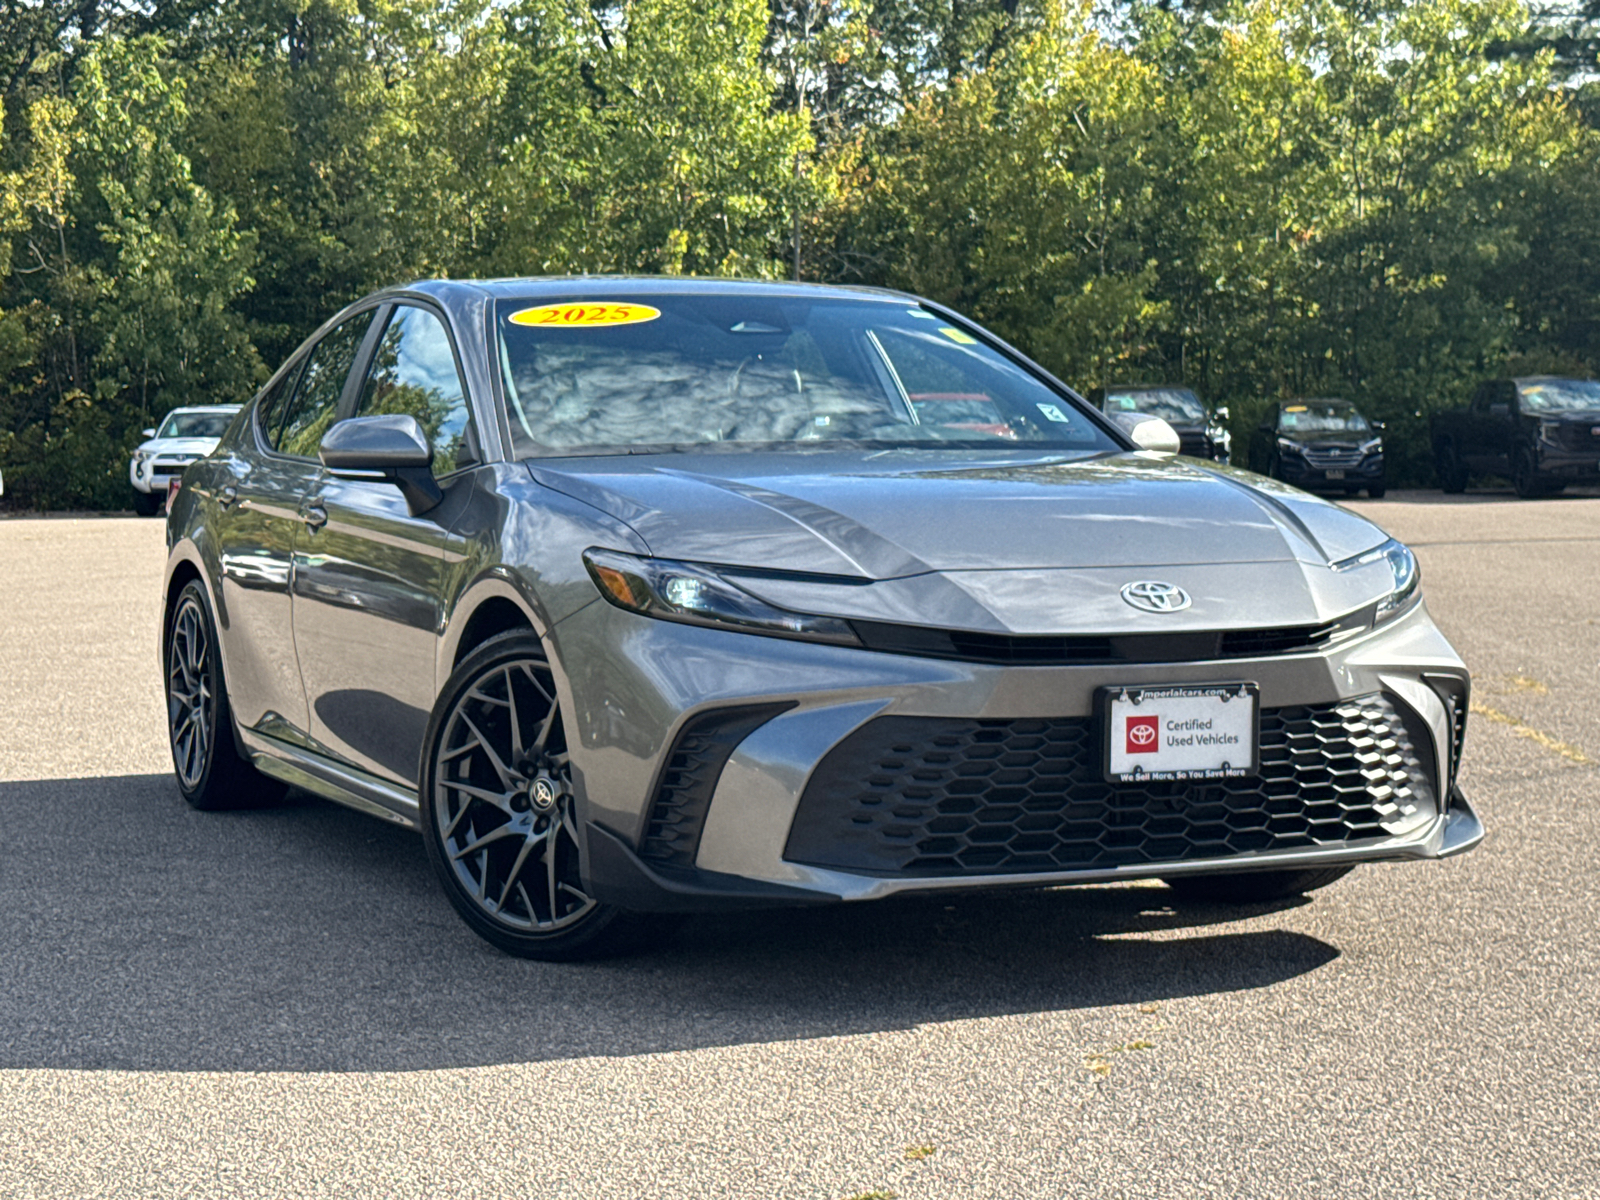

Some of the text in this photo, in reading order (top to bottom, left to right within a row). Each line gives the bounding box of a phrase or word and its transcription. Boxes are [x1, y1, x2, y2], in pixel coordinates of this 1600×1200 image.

[539, 306, 632, 324] 2025
[1166, 717, 1213, 731] Certified
[1166, 732, 1239, 747] Used Vehicles
[1120, 768, 1246, 782] We Sell More, So You Save More
